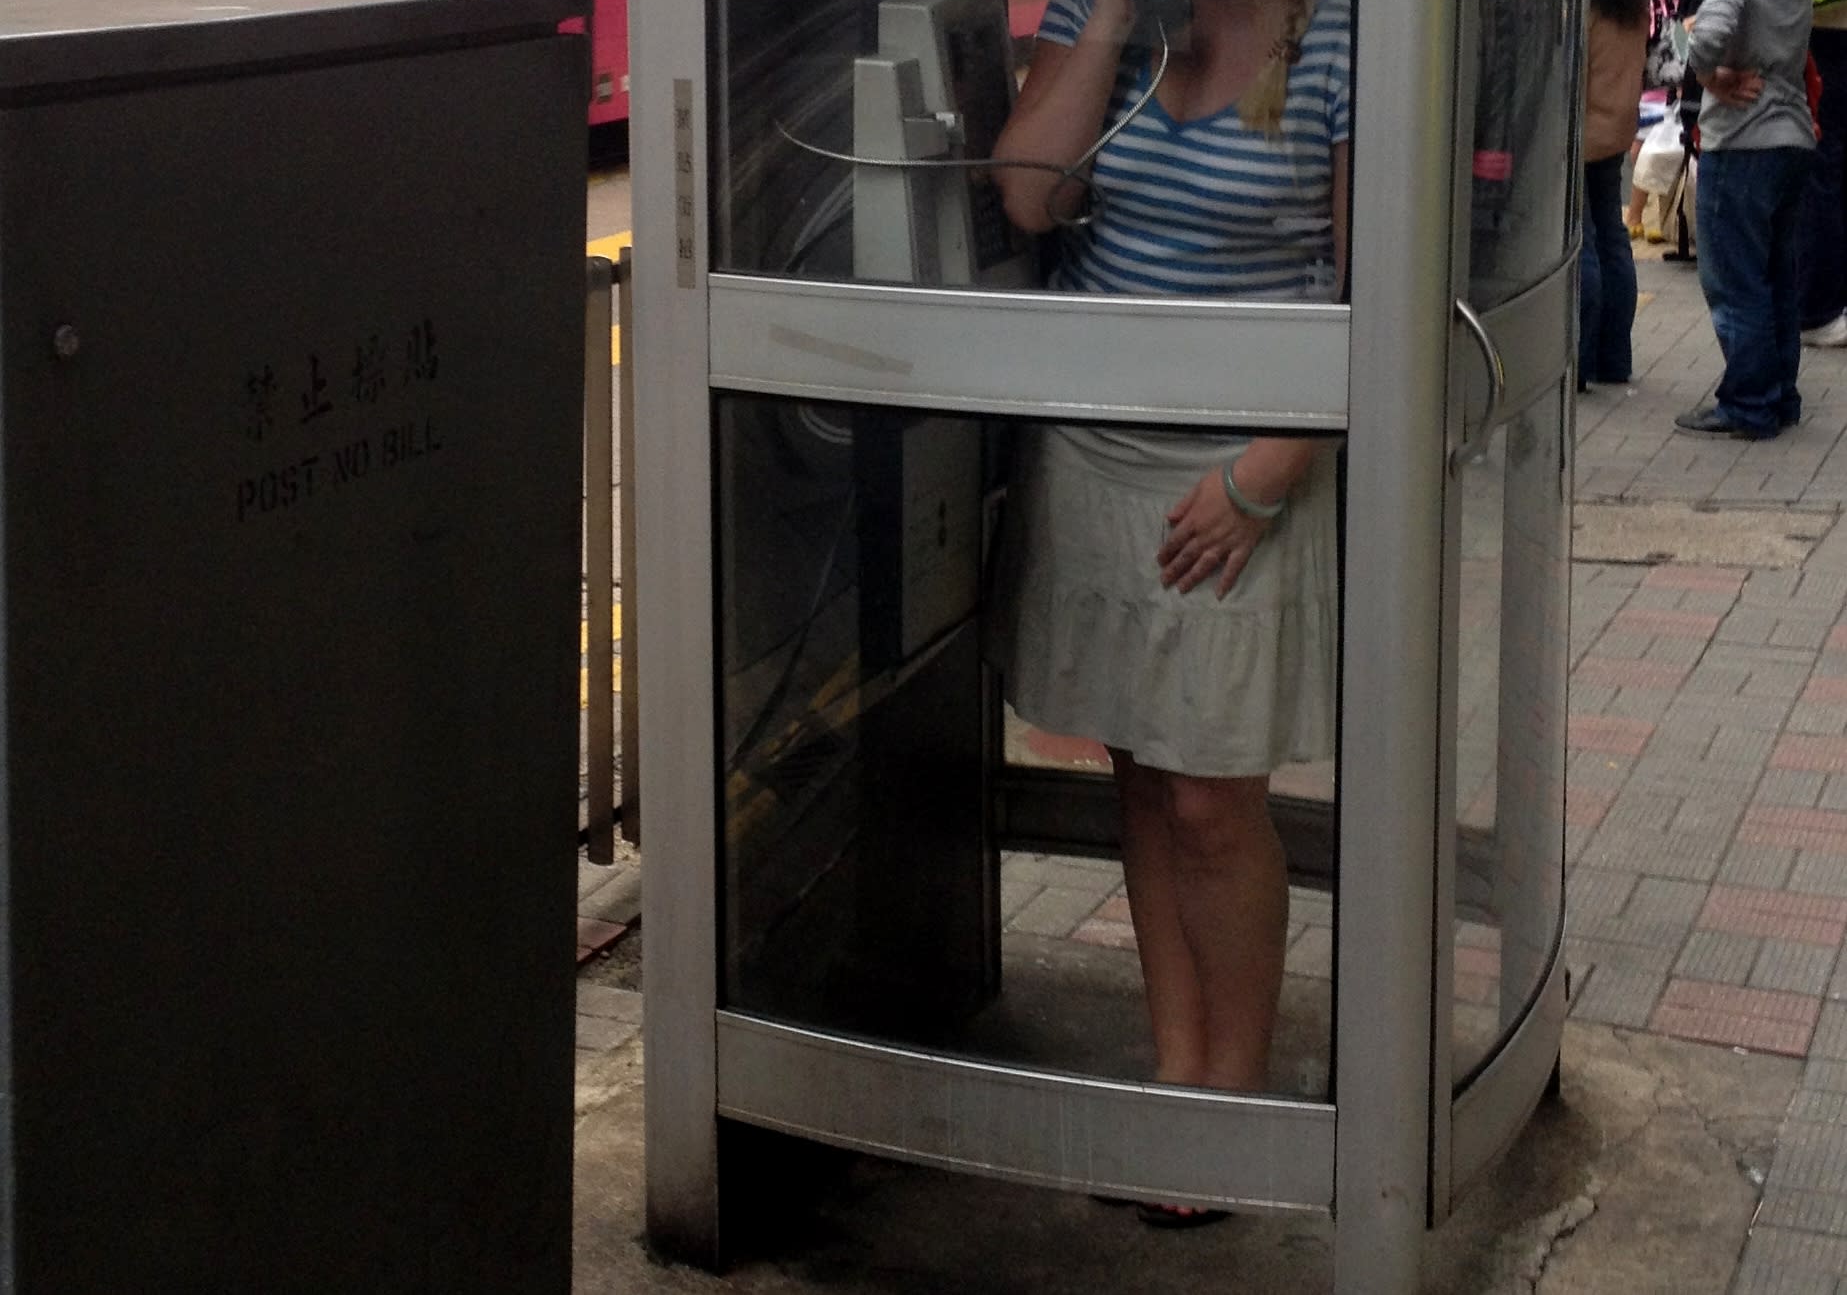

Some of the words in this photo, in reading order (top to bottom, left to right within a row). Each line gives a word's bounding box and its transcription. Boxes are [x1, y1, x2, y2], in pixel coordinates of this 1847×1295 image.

[237, 456, 320, 522] POST
[332, 440, 371, 486] NO
[381, 417, 443, 467] BILL
